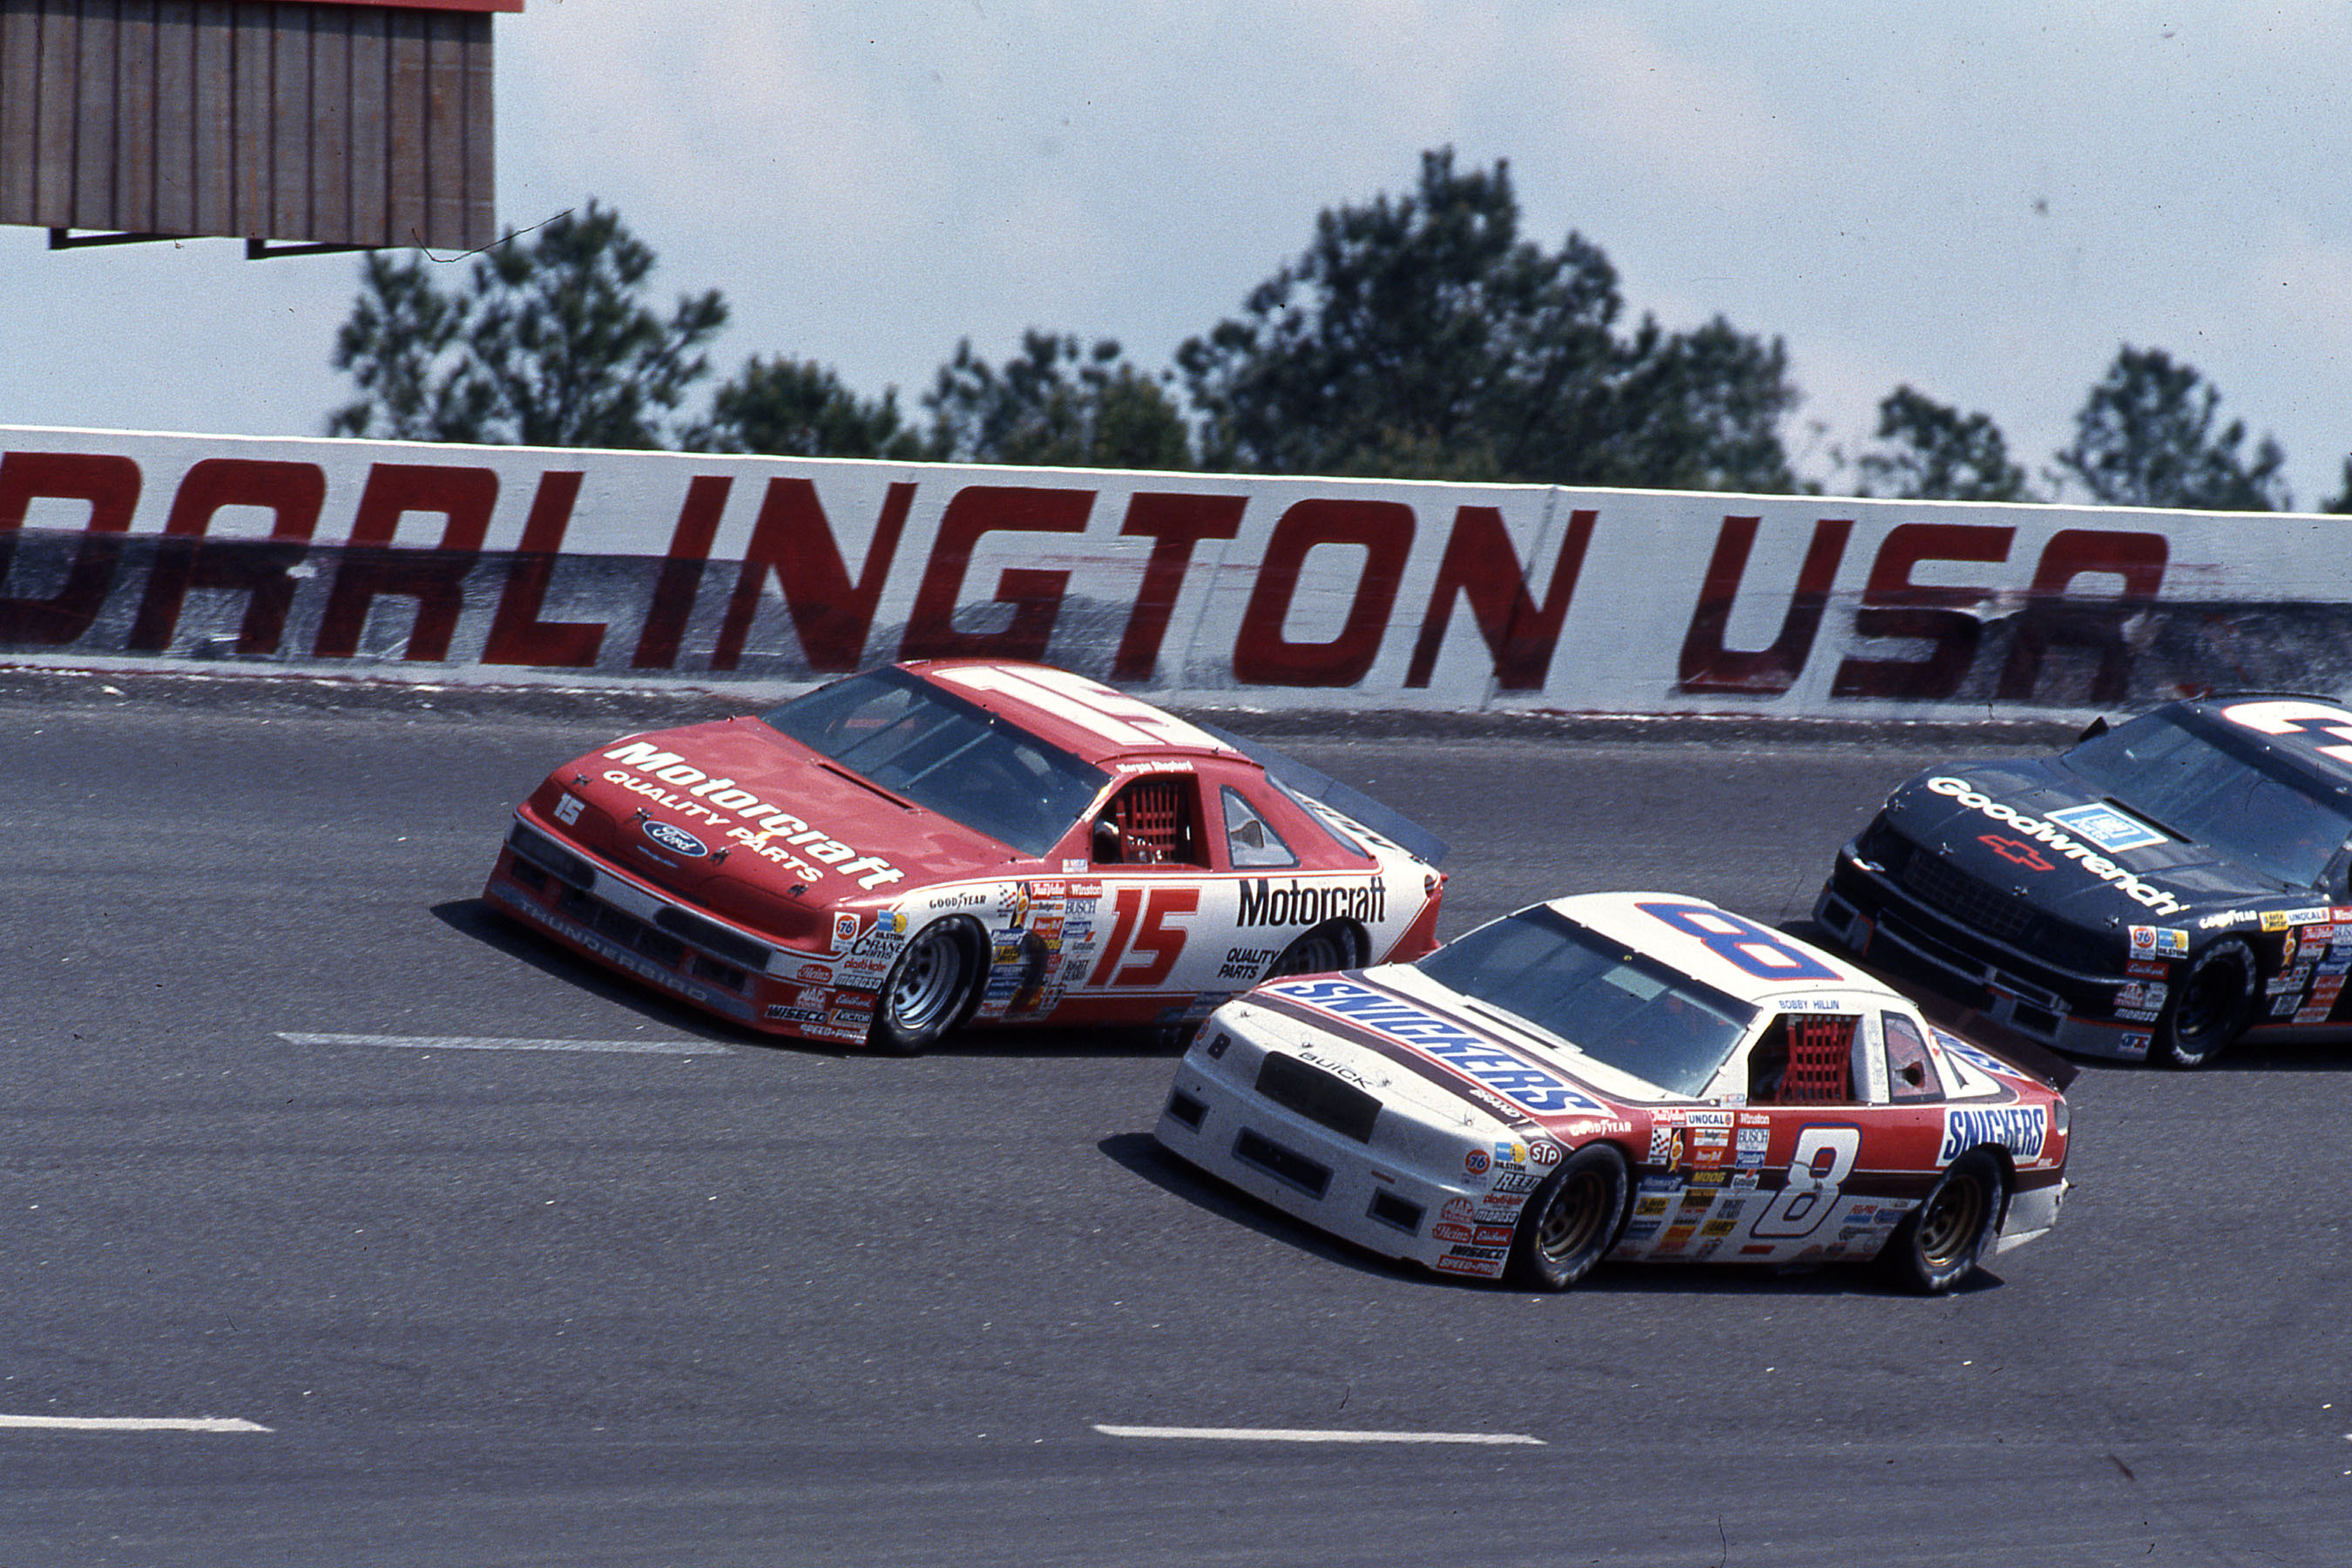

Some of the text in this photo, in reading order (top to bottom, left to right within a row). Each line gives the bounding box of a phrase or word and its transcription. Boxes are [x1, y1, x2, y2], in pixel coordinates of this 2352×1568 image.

[0, 452, 2170, 700] DARLINGTON USA
[552, 793, 585, 827] 15
[603, 741, 905, 890] Motorcraft
[603, 769, 824, 882] QUALITY PARTS
[1927, 776, 2183, 916] Goodwrench
[1071, 882, 1101, 896] Winston
[929, 893, 986, 909] GOODYEAR
[1065, 898, 1096, 914] BUSCH
[1235, 876, 1386, 928] Motorcraft
[838, 920, 855, 936] 76
[1083, 885, 1201, 990] 15
[2137, 930, 2152, 943] 76
[521, 899, 708, 1002] THUNDERBIRD
[1634, 902, 1845, 982] 8
[1226, 947, 1280, 965] QUALITY
[1218, 964, 1260, 980] PARTS
[765, 1004, 828, 1024] WISECO
[1779, 1000, 1840, 1010] BOBBY HILLIN
[1207, 1032, 1232, 1060] 8
[1274, 982, 1604, 1112] SNICKERS
[1298, 1051, 1374, 1088] BUICK
[1570, 1119, 1632, 1137] GOODYEAR
[1688, 1114, 1724, 1125] UNOCAL
[1740, 1112, 1770, 1125] Winston
[1739, 1130, 1769, 1143] BUSCH
[1943, 1109, 2044, 1160] SNICKERS
[1469, 1155, 1487, 1170] 76
[1531, 1143, 1558, 1164] STP
[1497, 1172, 1543, 1191] REED
[1692, 1172, 1727, 1183] MOOG
[1750, 1122, 1862, 1240] 8
